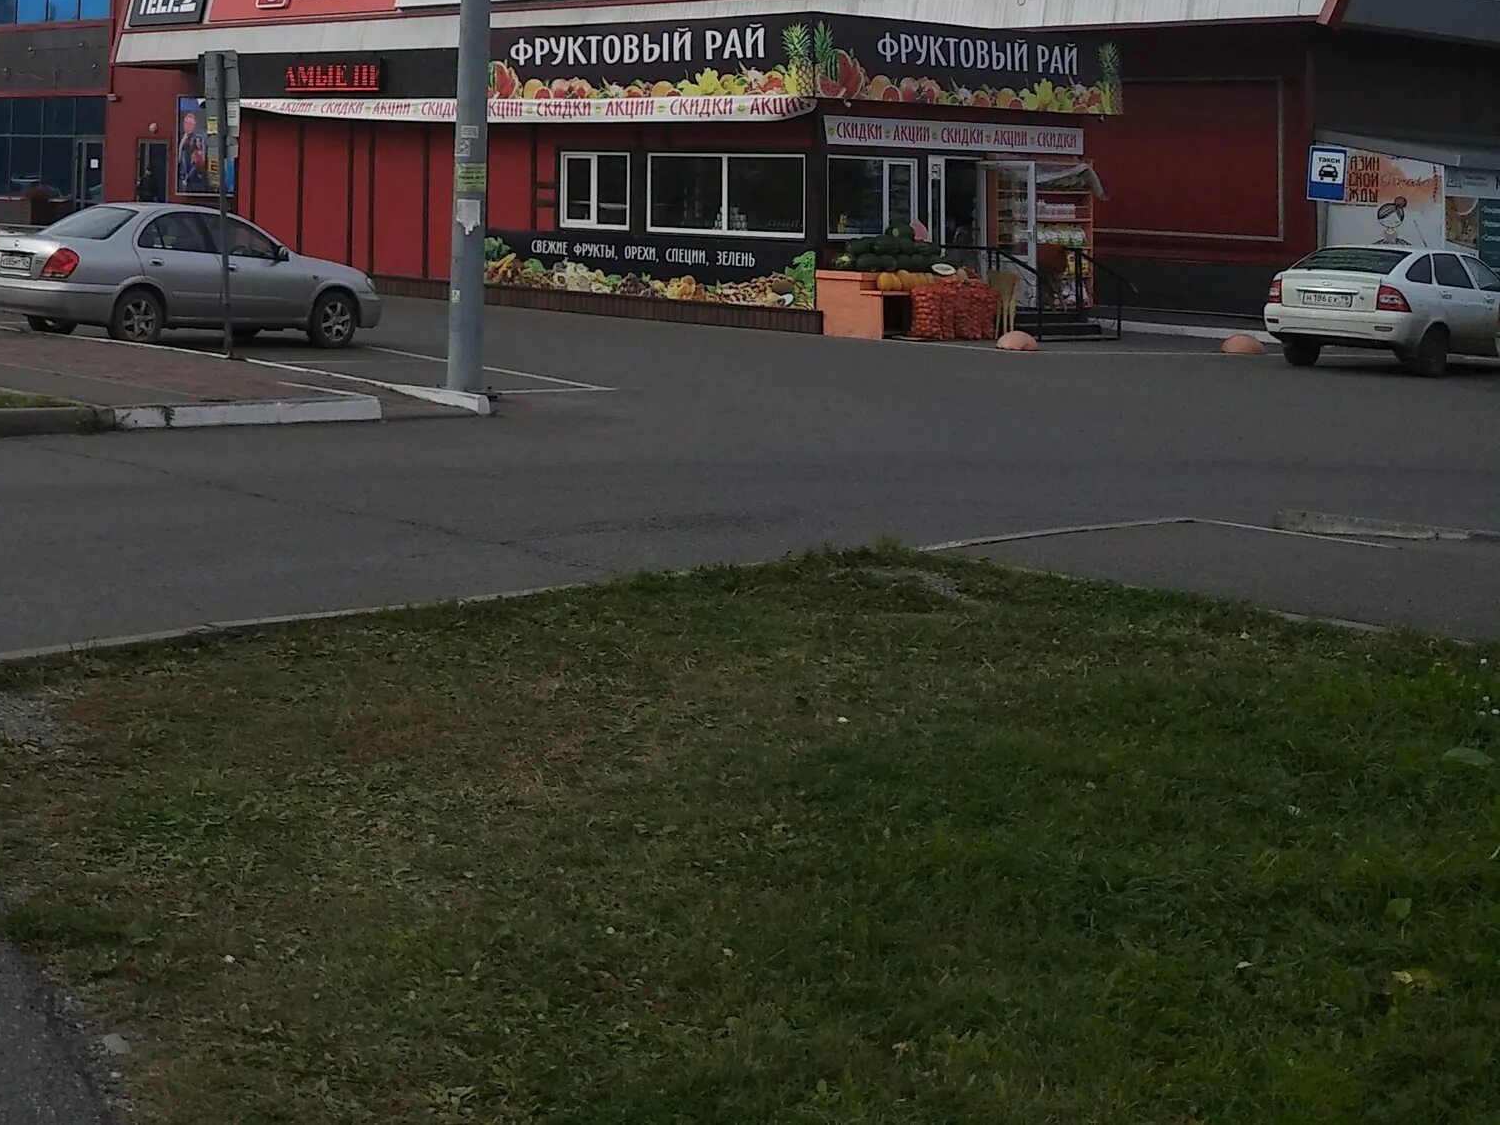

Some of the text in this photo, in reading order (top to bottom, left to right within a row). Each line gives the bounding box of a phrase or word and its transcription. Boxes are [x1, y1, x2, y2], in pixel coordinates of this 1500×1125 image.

[510, 23, 766, 66] ФРУКТОВЫЙ РАЙ
[877, 32, 1078, 76] ФРУКТОВЫЙ РАЙ
[321, 101, 364, 115] СКИДКИ
[372, 101, 410, 116] АКЦИИ
[421, 101, 458, 118] СКИДК
[488, 101, 523, 119] КЦИИ
[536, 99, 591, 119] СКИДКИ
[605, 98, 655, 118] АКЦИИ
[670, 97, 733, 117] СКИДКИ
[836, 121, 1077, 149] СКИДКИ АКЦИИ СКИДКИ АКЦИИ СКИДКИ
[1350, 155, 1380, 172] АЗИН
[1349, 172, 1379, 188] СКОЙ
[1349, 188, 1378, 204] ЖДЫ
[531, 239, 756, 268] СВЕЖИЕ ФРУКТЫ, ОРЕХИ, СПЕЦИИ, ЗЕЛЕНЬ
